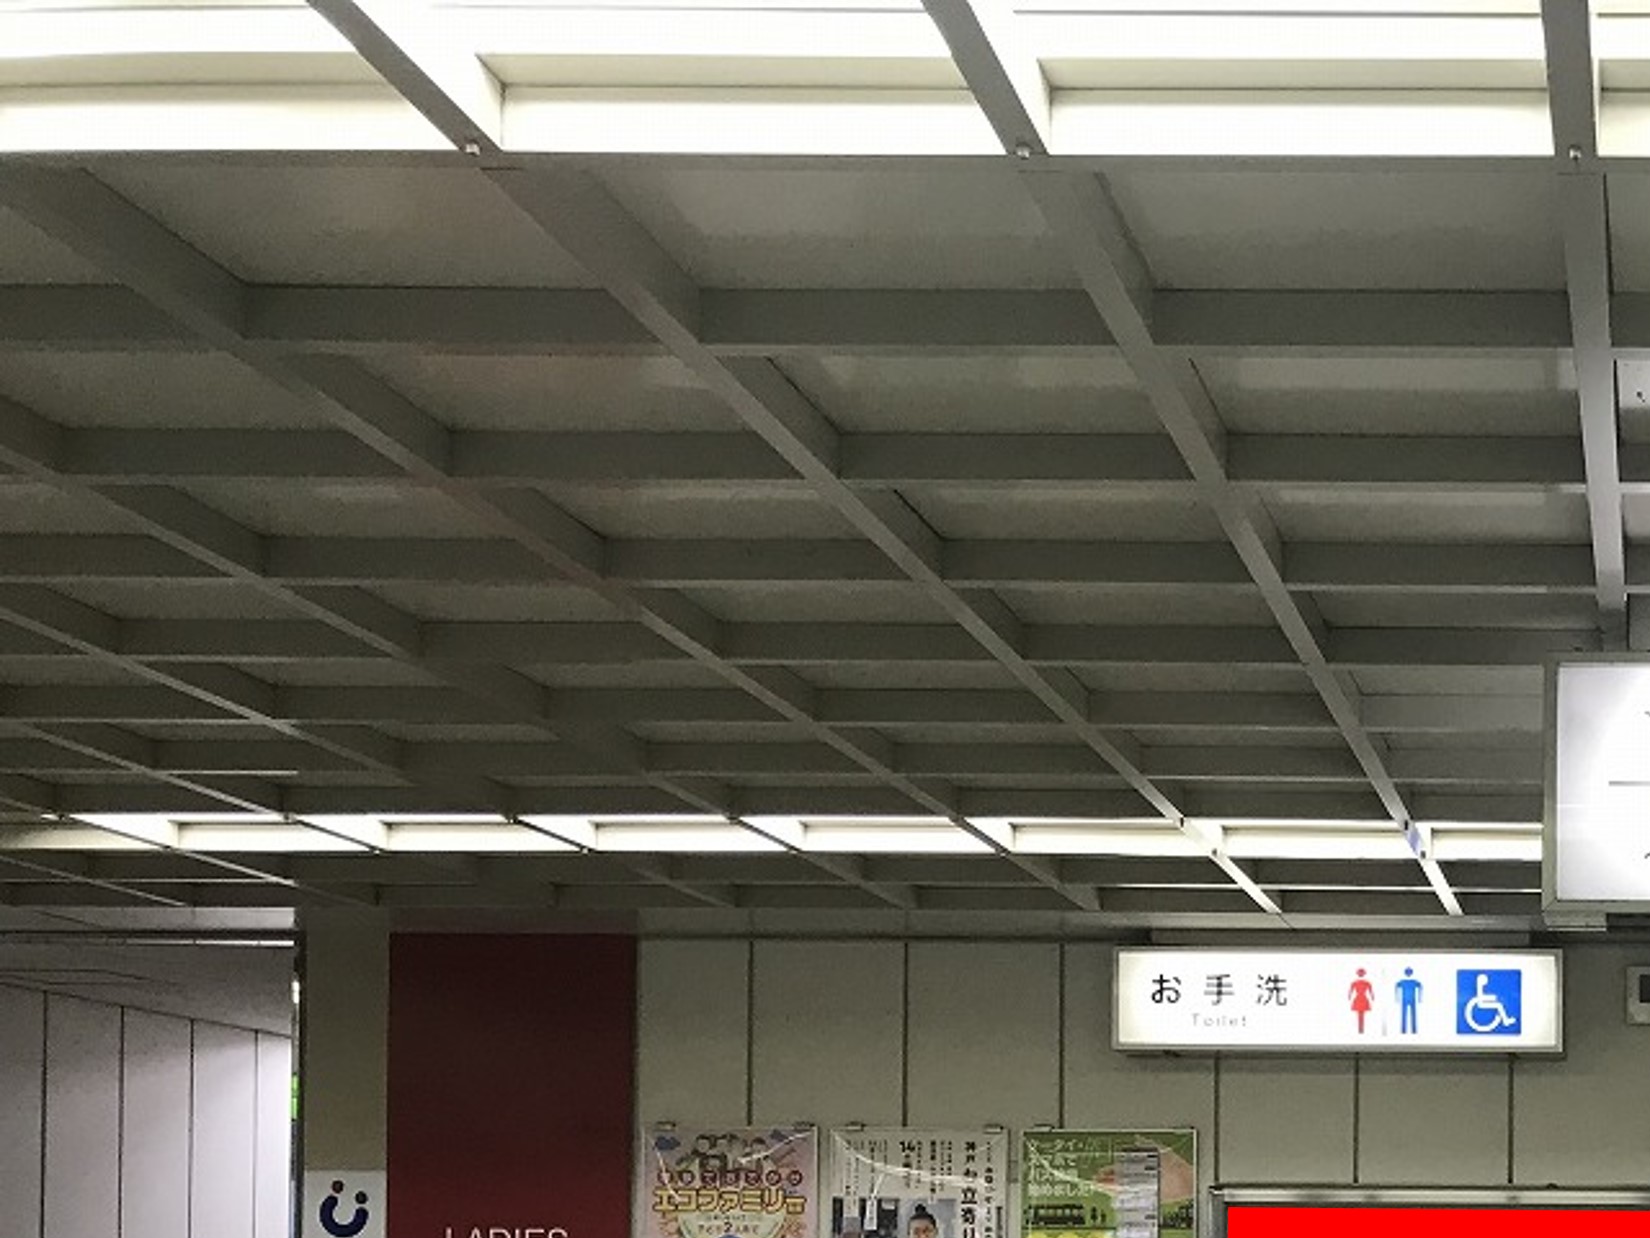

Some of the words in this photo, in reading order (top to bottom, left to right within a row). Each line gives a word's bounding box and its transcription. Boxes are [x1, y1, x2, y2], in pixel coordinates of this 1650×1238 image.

[1151, 973, 1287, 1006] お手洗
[1191, 1012, 1248, 1028] Toilet
